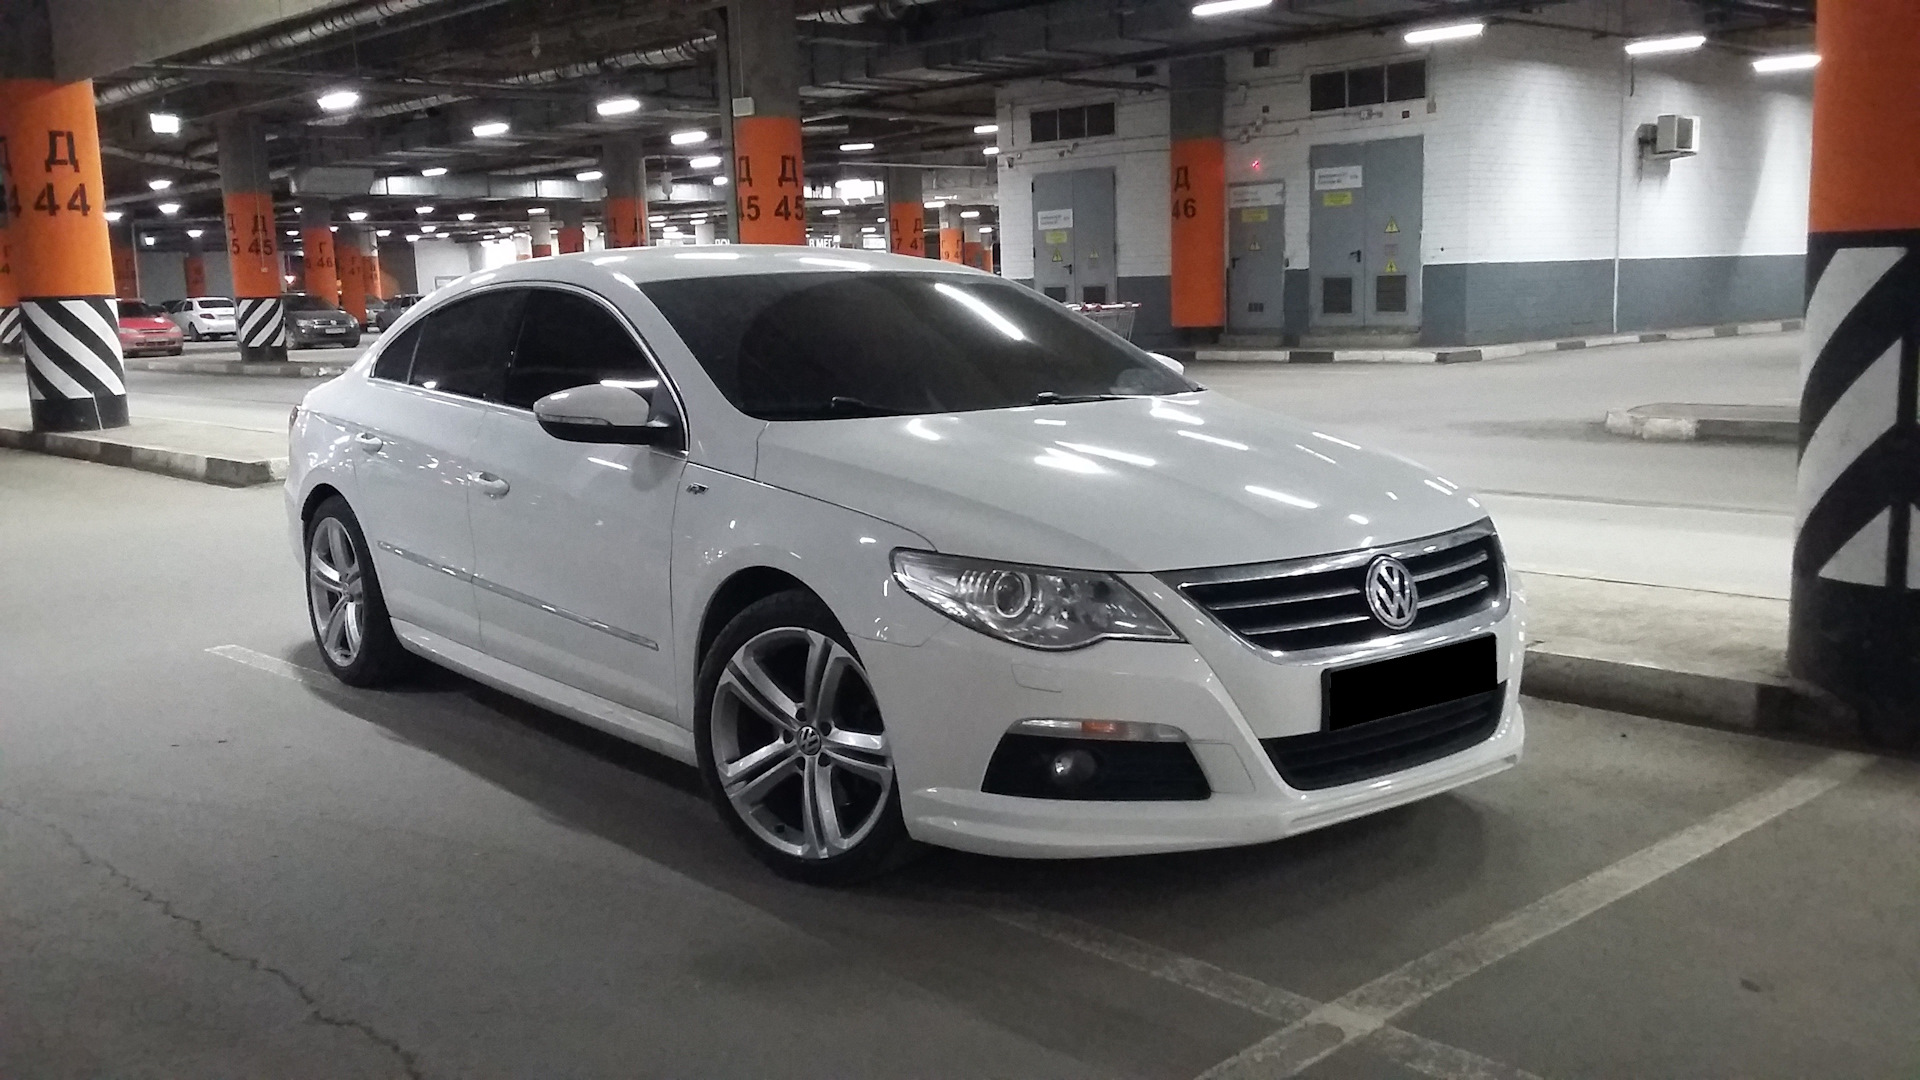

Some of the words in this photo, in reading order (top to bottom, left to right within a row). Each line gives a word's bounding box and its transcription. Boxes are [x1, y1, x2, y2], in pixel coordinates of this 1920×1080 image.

[44, 130, 80, 173] Д
[778, 155, 798, 187] Д
[1174, 166, 1190, 192] Д
[33, 182, 91, 217] 44
[774, 195, 804, 221] 45
[1172, 198, 1196, 219] 46
[231, 238, 240, 255] 5
[248, 239, 273, 256] 45
[895, 237, 903, 250] 7
